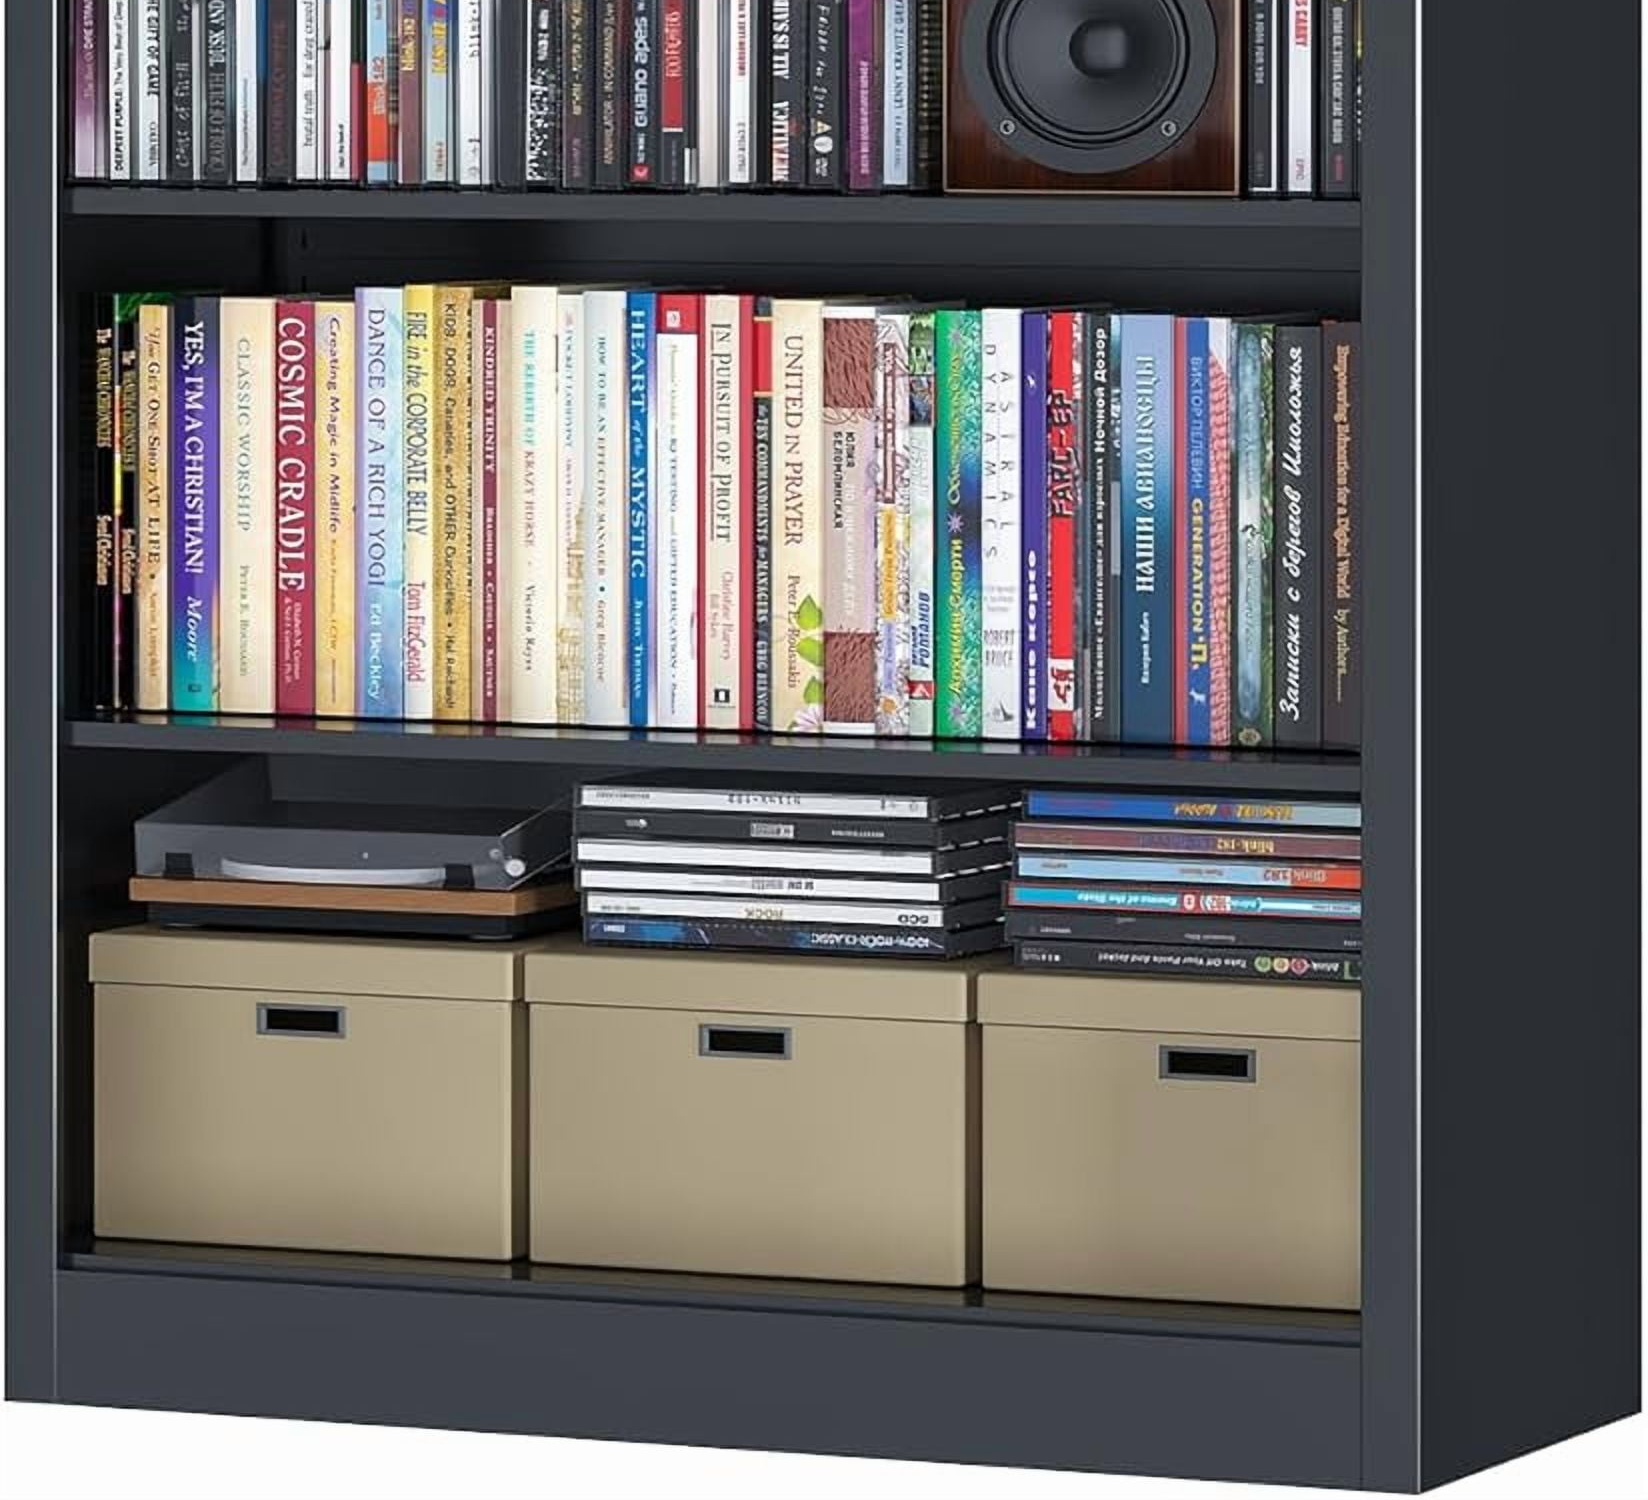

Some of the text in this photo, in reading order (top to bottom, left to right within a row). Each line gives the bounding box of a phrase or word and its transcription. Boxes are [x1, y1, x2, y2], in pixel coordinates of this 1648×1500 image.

[773, 34, 790, 49] IS
[773, 52, 790, 80] ALL
[773, 101, 790, 181] METALLICA
[148, 361, 160, 393] GET
[631, 310, 645, 414] HEART
[1094, 328, 1107, 382] Дозор
[1333, 344, 1350, 422] Empowering
[148, 398, 160, 430] ONE
[237, 338, 251, 531] CLASSIC WORSHIP
[326, 317, 341, 533] Creating Magic in Midlife
[407, 311, 427, 536] FIRE in the CORPORATE BELLY
[485, 326, 495, 474] KINDRED TRINITY
[710, 323, 731, 542] IN PURSUIT OF PROFIT
[1094, 387, 1106, 452] Ночной
[1191, 356, 1203, 489] ВИКТОР ПЕЛЕВИН
[278, 317, 305, 591] COSMIC CRADLE
[368, 309, 385, 587] DANCE OF A RICH YOGI
[445, 464, 456, 489] and
[785, 335, 803, 546] UNITED IN PRAYER
[846, 431, 855, 468] ЮЛИЯ
[1136, 356, 1158, 592] НАШИ АВИАНОСЦЫ
[1337, 425, 1351, 484] Education
[148, 481, 160, 507] AT
[181, 320, 204, 663] YES, I'M A CHRISTIAN! Moore
[445, 494, 456, 541] OTHER
[631, 467, 645, 578] MYSTIC
[1337, 487, 1351, 504] for
[148, 517, 160, 564] LIFE
[1191, 498, 1203, 632] GENERATION
[1282, 485, 1306, 578] берегов
[1333, 517, 1351, 557] Digital
[788, 574, 801, 606] Peter
[1288, 587, 1300, 602] с
[1334, 609, 1351, 624] by
[1337, 560, 1351, 598] World
[367, 602, 382, 700] Ed Beckley
[407, 581, 426, 682] Tom FitzGerald
[1279, 614, 1300, 720] Записки
